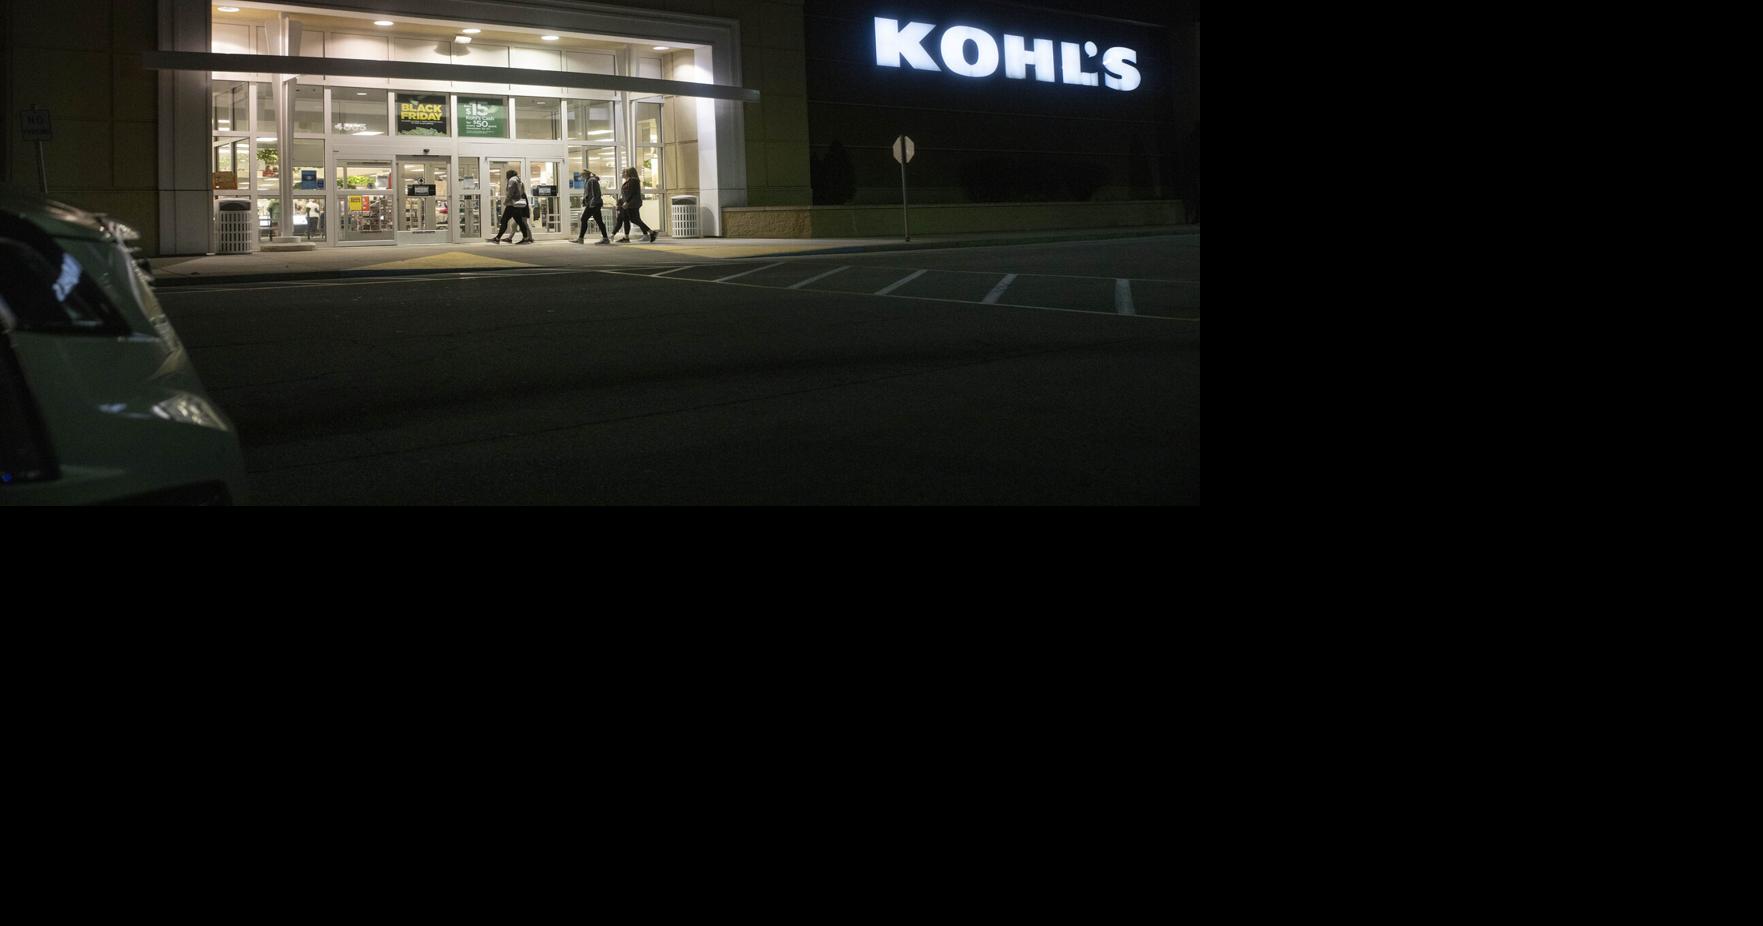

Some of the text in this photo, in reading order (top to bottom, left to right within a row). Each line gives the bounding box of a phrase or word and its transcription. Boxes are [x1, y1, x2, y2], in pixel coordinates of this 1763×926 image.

[874, 16, 1141, 91] KOHL'S
[401, 103, 442, 113] BLACK
[400, 112, 443, 120] FRIDAY
